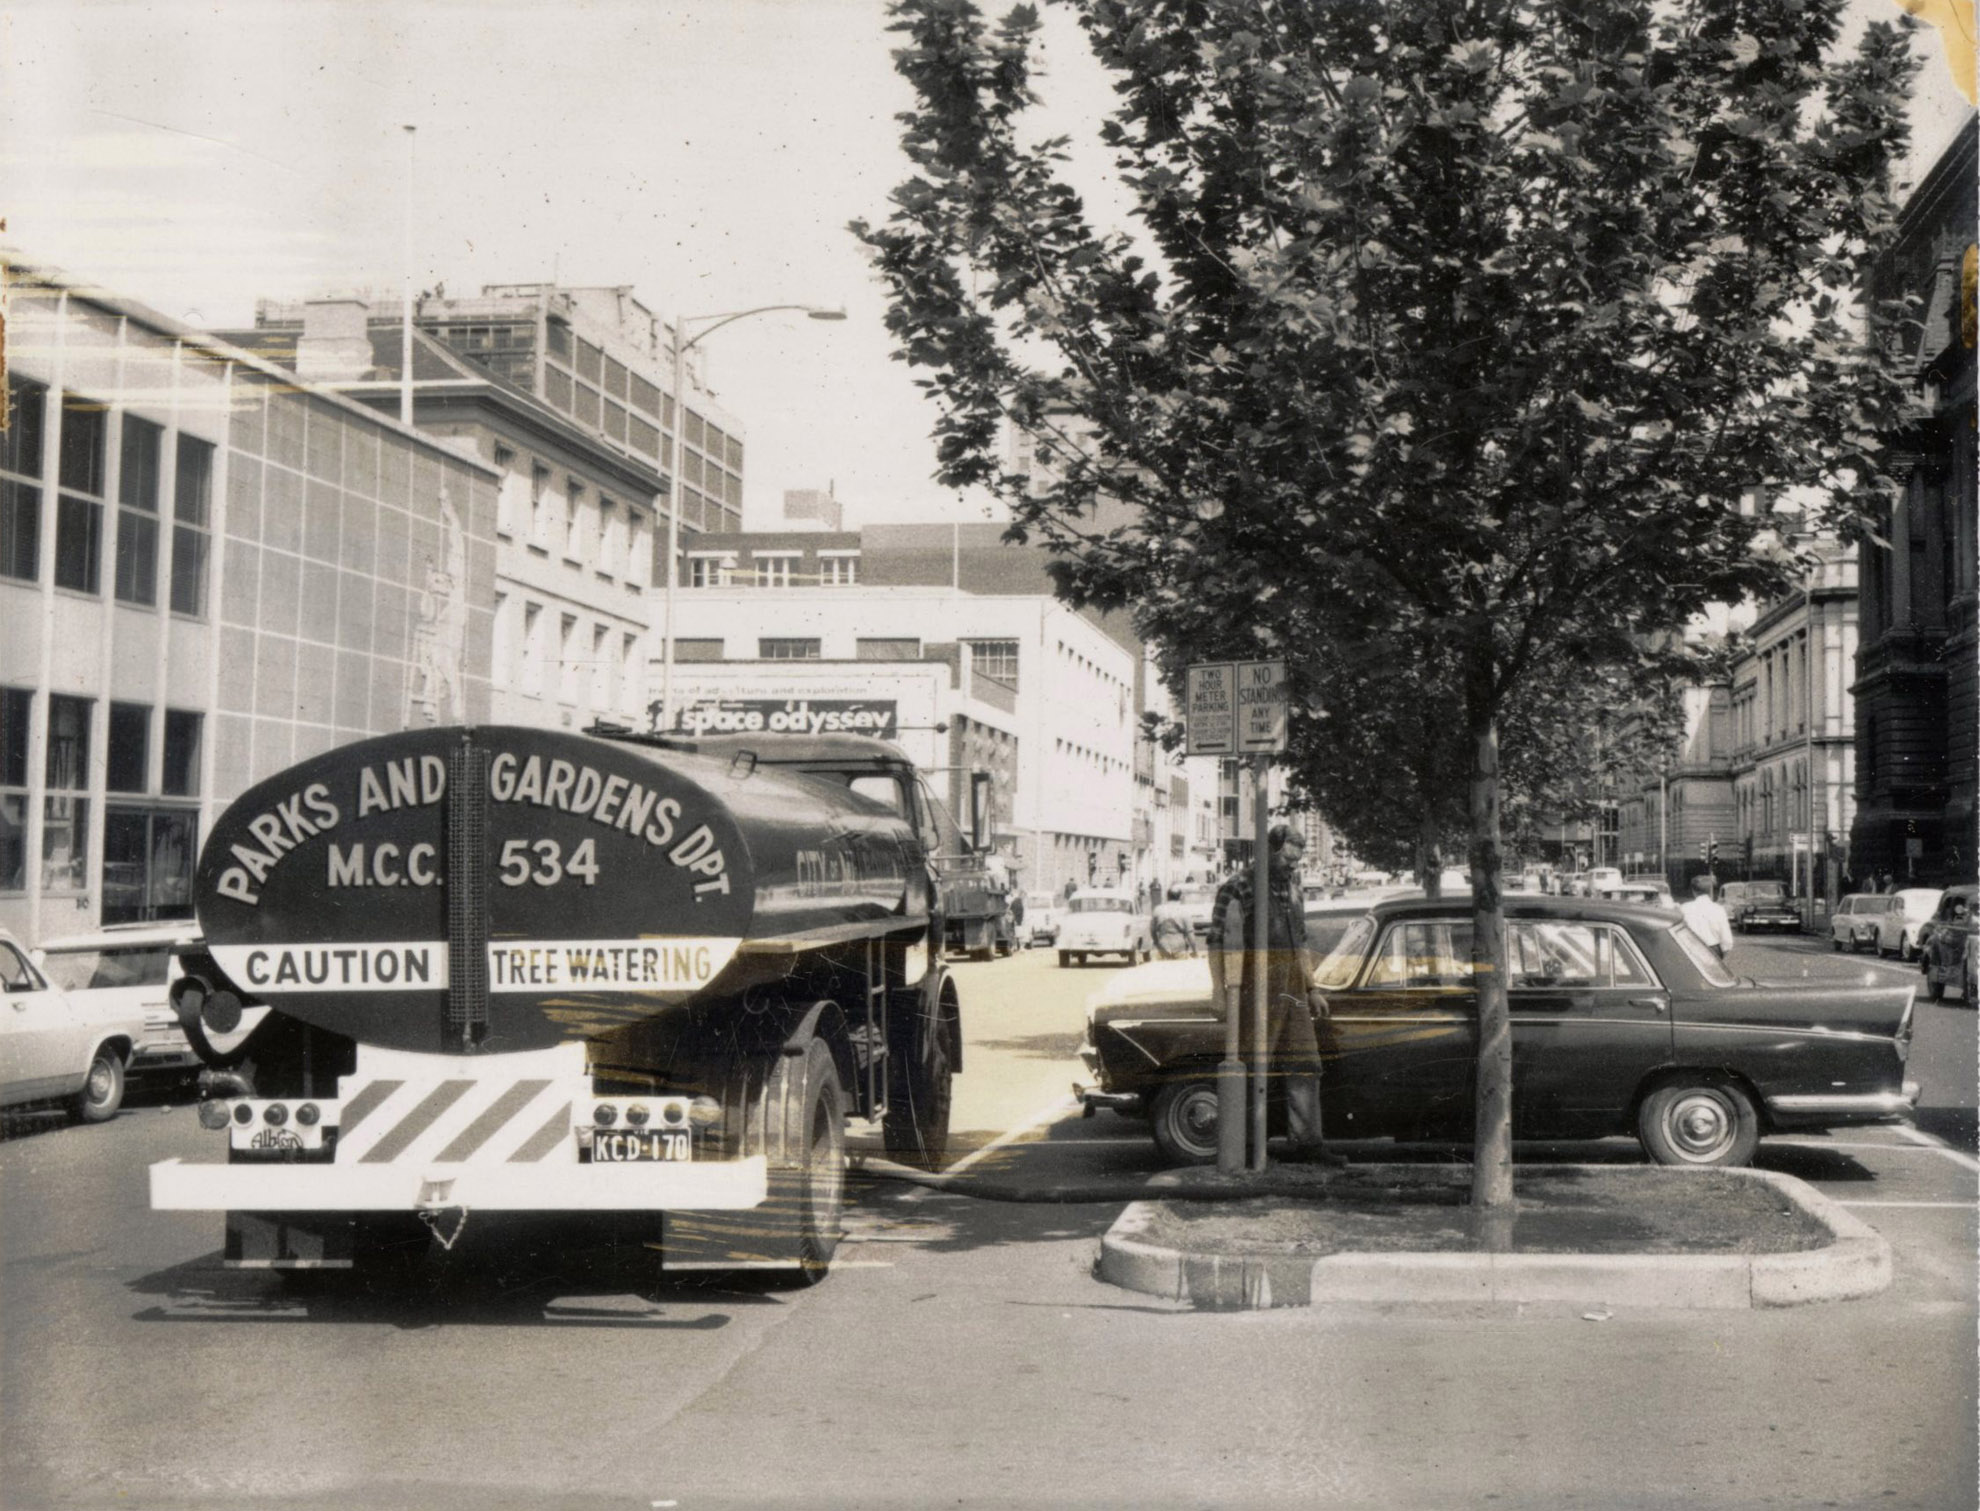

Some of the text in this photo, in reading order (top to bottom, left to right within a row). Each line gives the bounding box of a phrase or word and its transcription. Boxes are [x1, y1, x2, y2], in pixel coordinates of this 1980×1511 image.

[1201, 670, 1221, 679] TWO
[1253, 667, 1271, 684] NO
[1199, 680, 1222, 690] HOUR
[1195, 690, 1226, 701] METER
[1240, 687, 1284, 706] STANDIN
[1191, 701, 1229, 713] PARKING
[1252, 707, 1271, 719] ANY
[681, 710, 765, 737] space
[769, 701, 892, 738] odyssey
[1251, 721, 1271, 734] TIME
[216, 783, 340, 905] PARKS
[358, 755, 446, 818] AND
[490, 752, 682, 846] GARDENS
[328, 838, 599, 887] M.C.C. 534
[246, 946, 711, 985] CAUTION TREE WATERING
